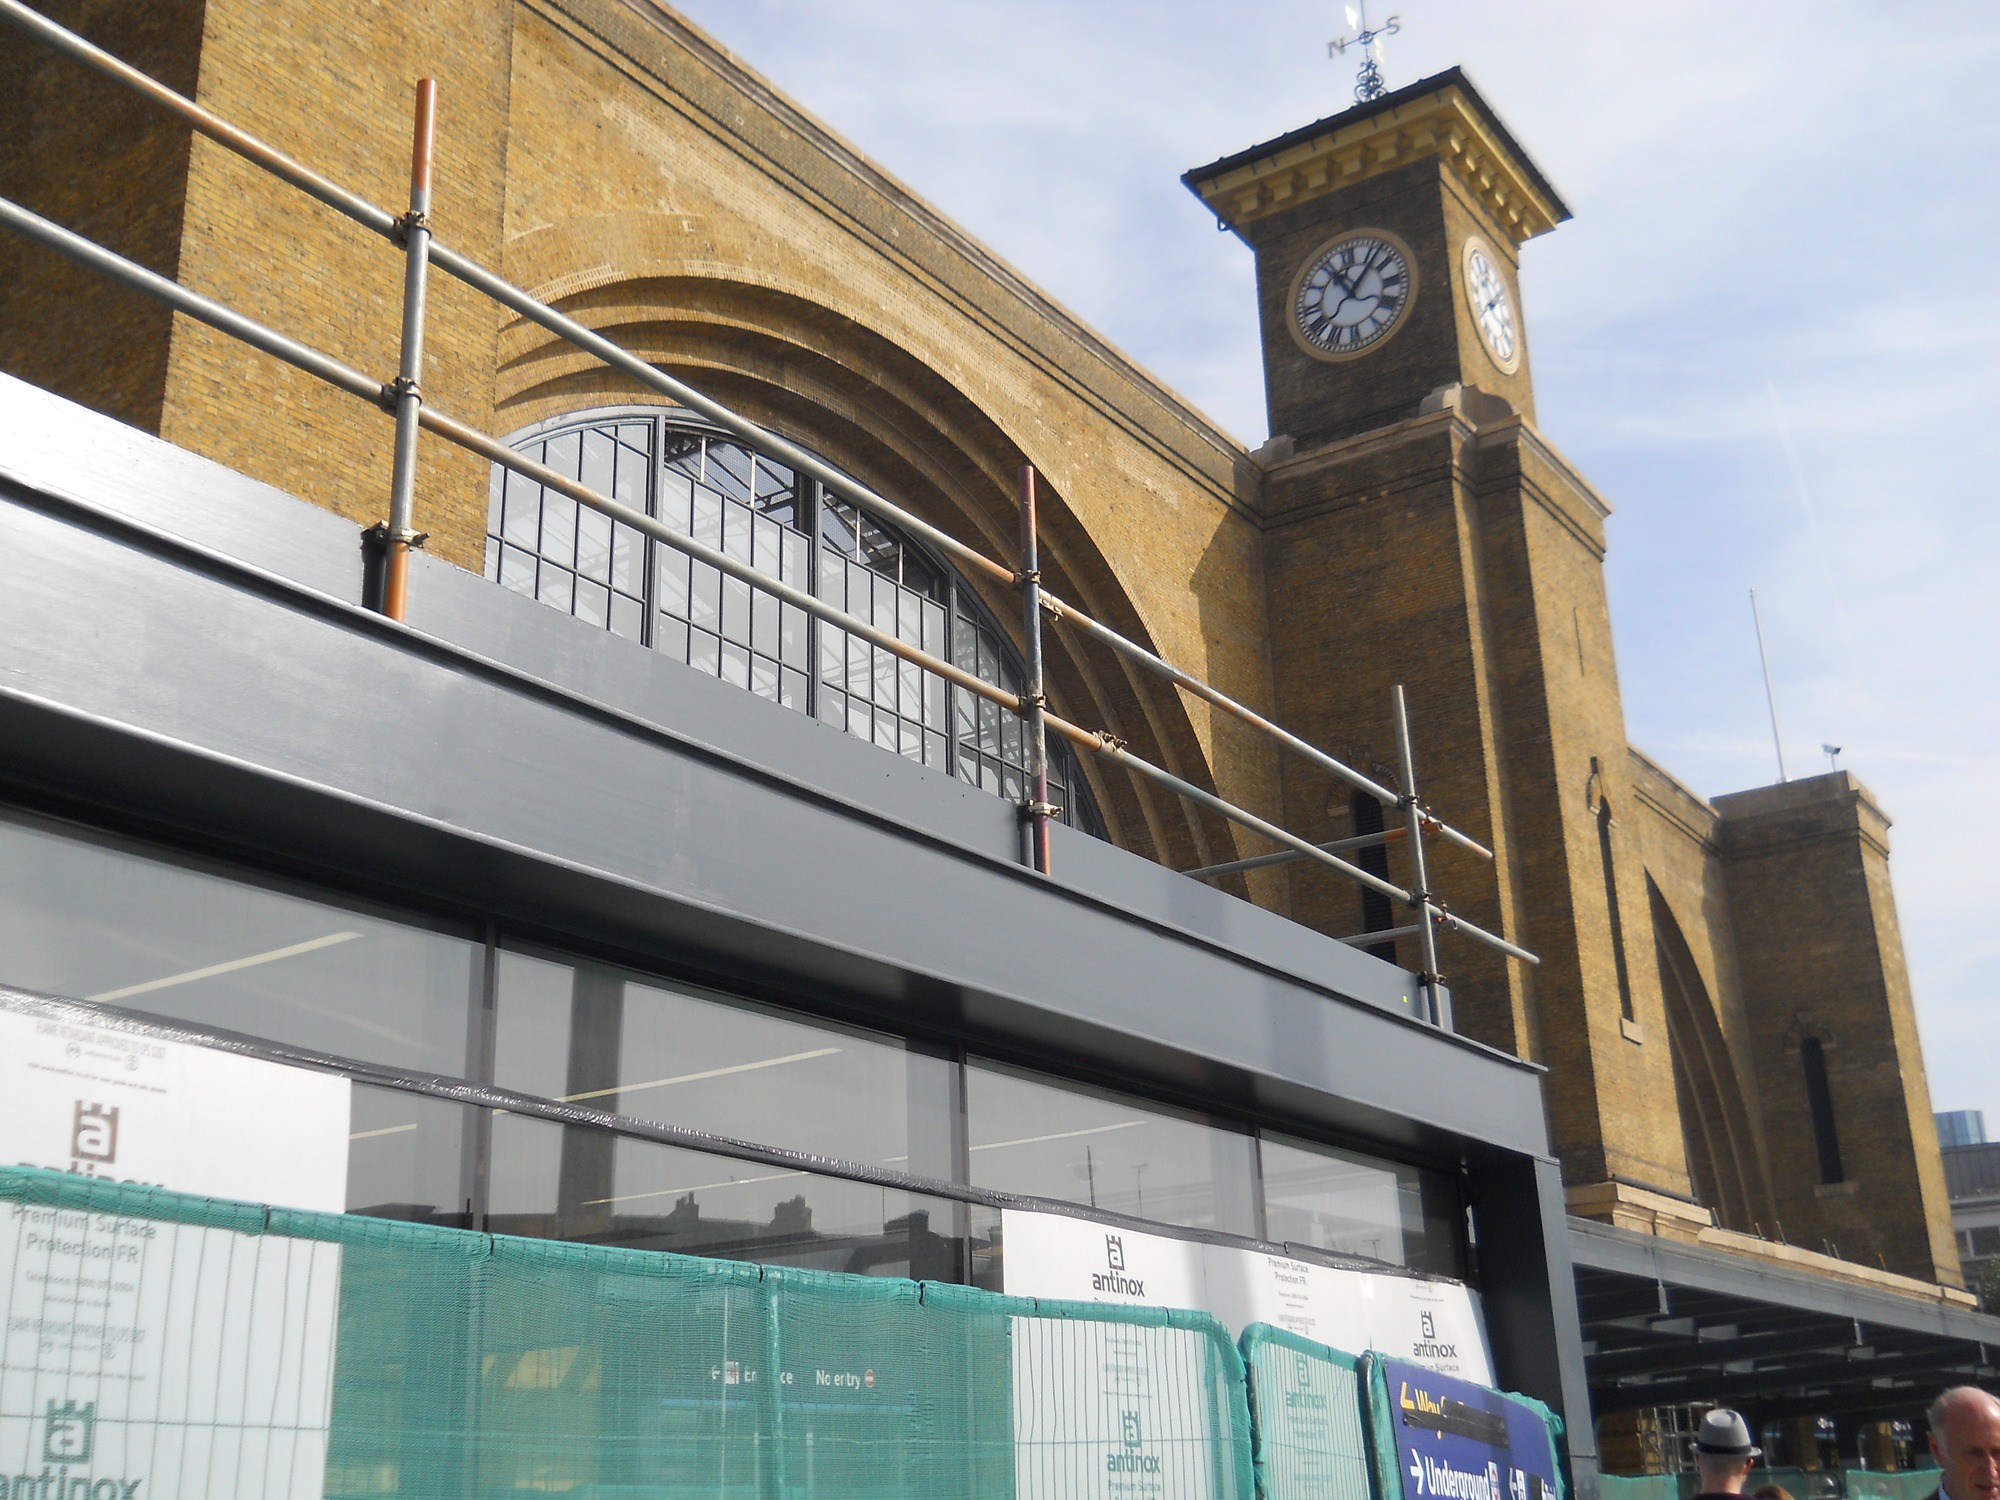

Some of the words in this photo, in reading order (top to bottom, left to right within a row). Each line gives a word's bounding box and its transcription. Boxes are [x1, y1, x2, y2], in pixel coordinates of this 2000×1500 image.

[1386, 15, 1400, 35] S
[1326, 37, 1346, 59] N
[10, 1203, 88, 1230] Premium
[94, 1214, 156, 1240] Surface
[26, 1231, 112, 1259] Protection
[116, 1244, 139, 1264] FR
[1092, 1270, 1145, 1297] antinox
[1413, 1339, 1458, 1358] antinox
[1435, 1363, 1460, 1374] Surface
[1286, 1389, 1328, 1410] antinox
[1107, 1449, 1160, 1473] antinox
[1425, 1455, 1491, 1500] Underground
